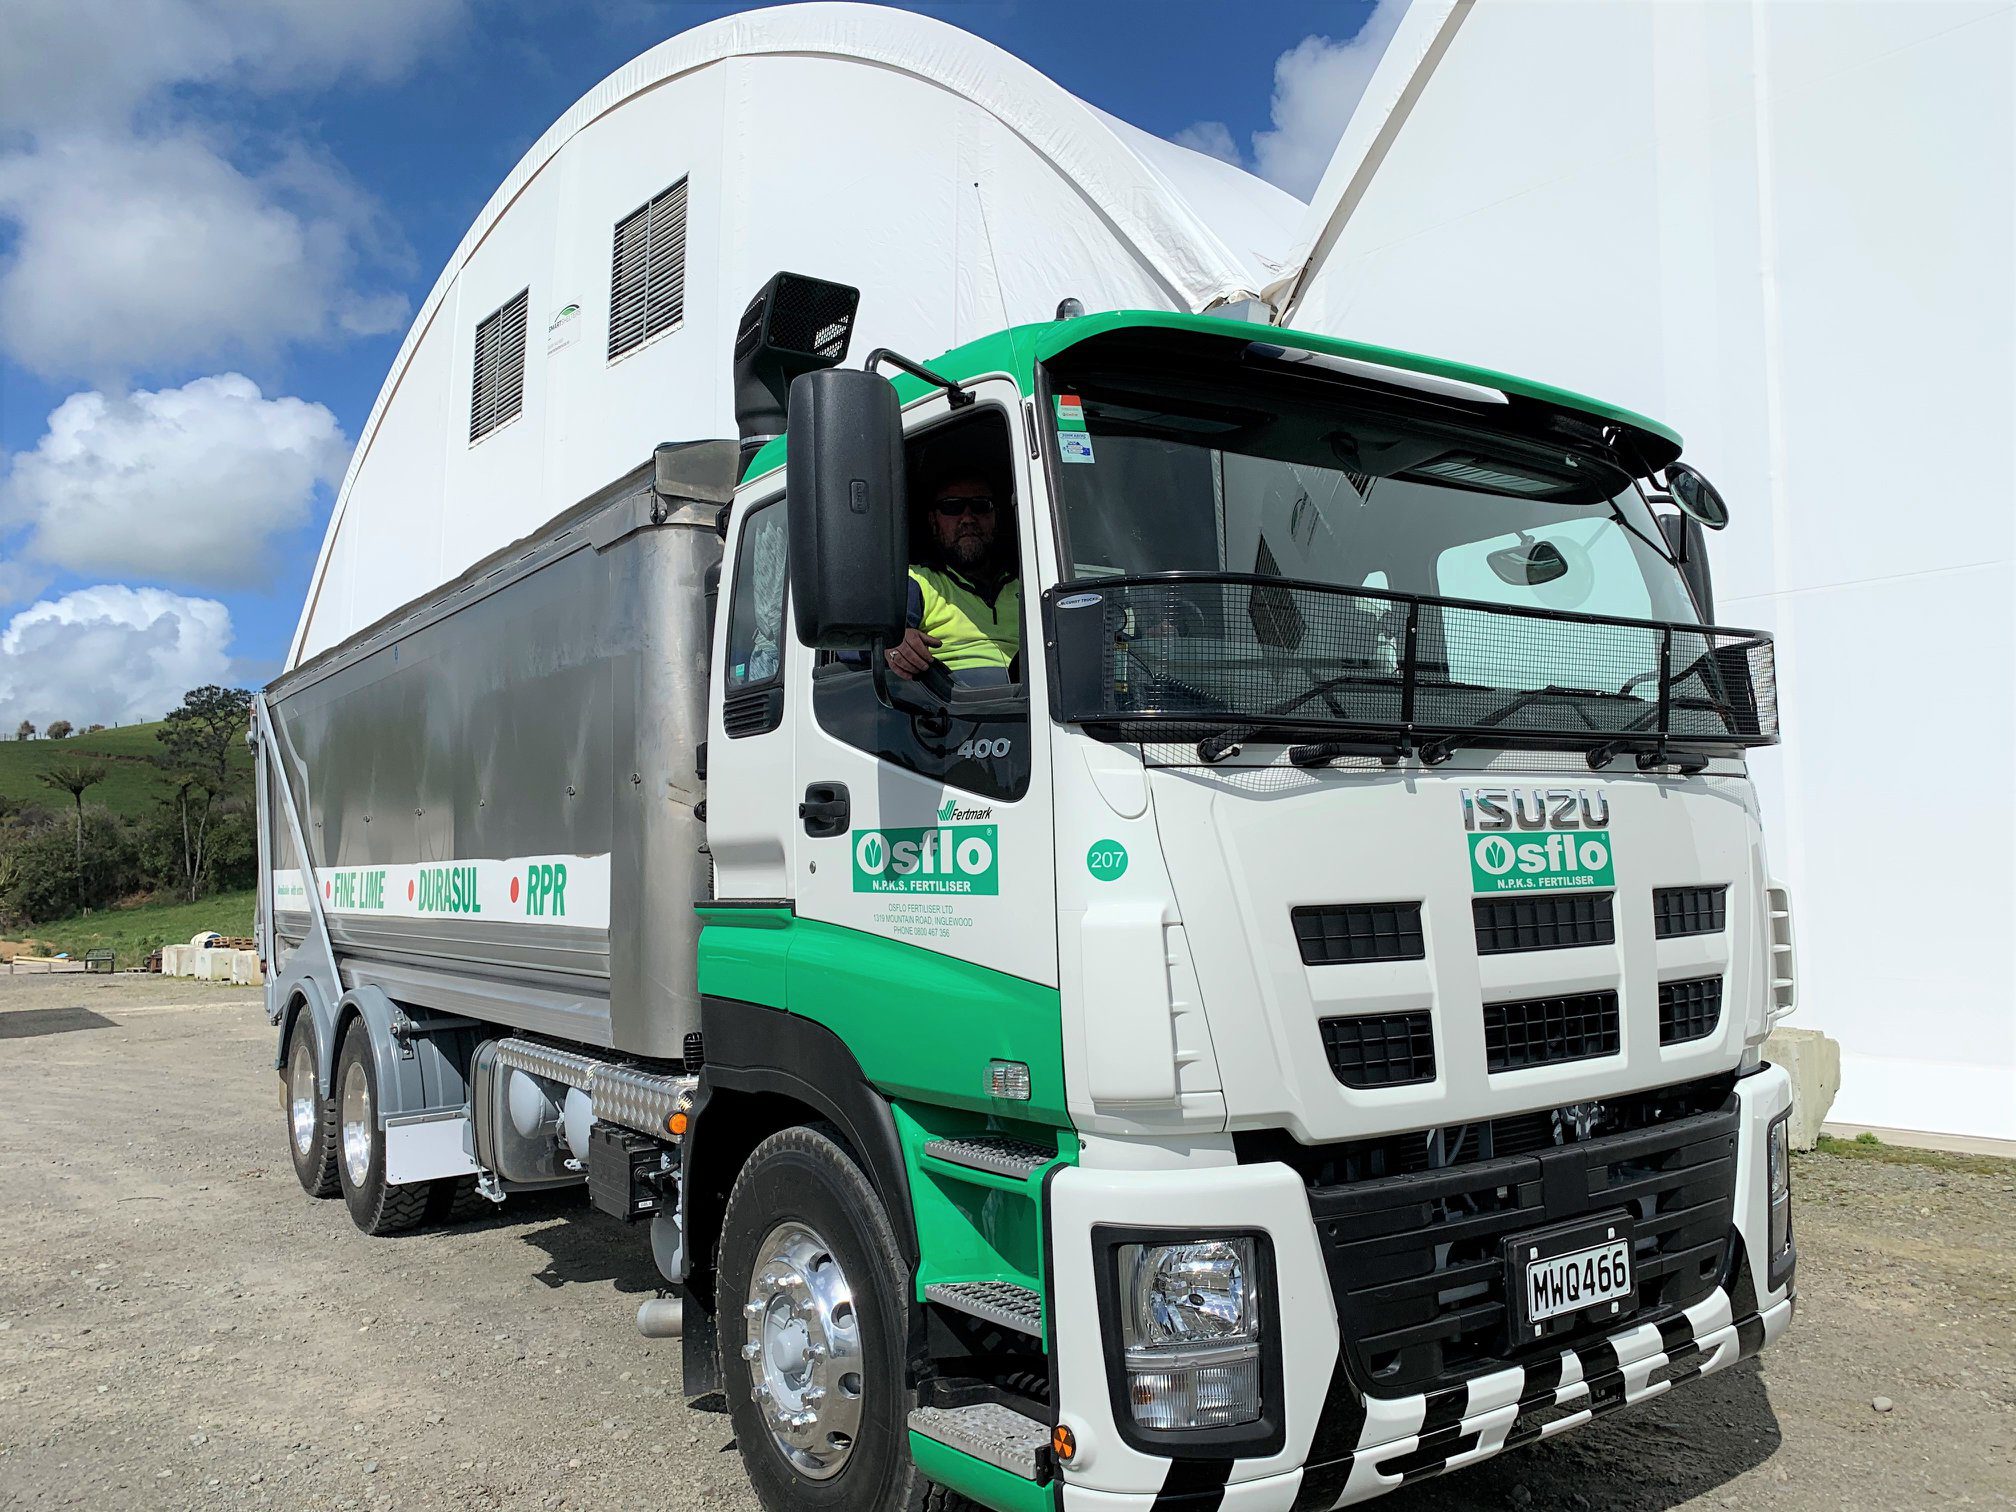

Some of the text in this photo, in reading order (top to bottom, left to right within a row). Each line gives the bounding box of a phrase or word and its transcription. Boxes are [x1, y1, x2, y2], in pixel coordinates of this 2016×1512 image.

[957, 737, 1011, 759] 400
[950, 806, 993, 822] Fertmark
[1459, 788, 1610, 831] ISUZU
[856, 829, 993, 876] Osflo
[1091, 851, 1125, 869] 207
[1474, 834, 1609, 875] Osflo
[334, 870, 386, 909] FINE LIME
[418, 866, 481, 914] DURASUL
[526, 863, 567, 916] RPR
[872, 880, 971, 893] N.P.K.S. FERTILISER
[1497, 875, 1595, 889] N.P.K.S. FERTILISER
[888, 903, 954, 915] OSFLO FERTILISER LTD
[885, 914, 915, 924] MOUNTAIN
[934, 917, 973, 927] INGLEWOOD
[893, 926, 914, 936] PHONE
[1533, 1249, 1627, 1312] MWQ466
